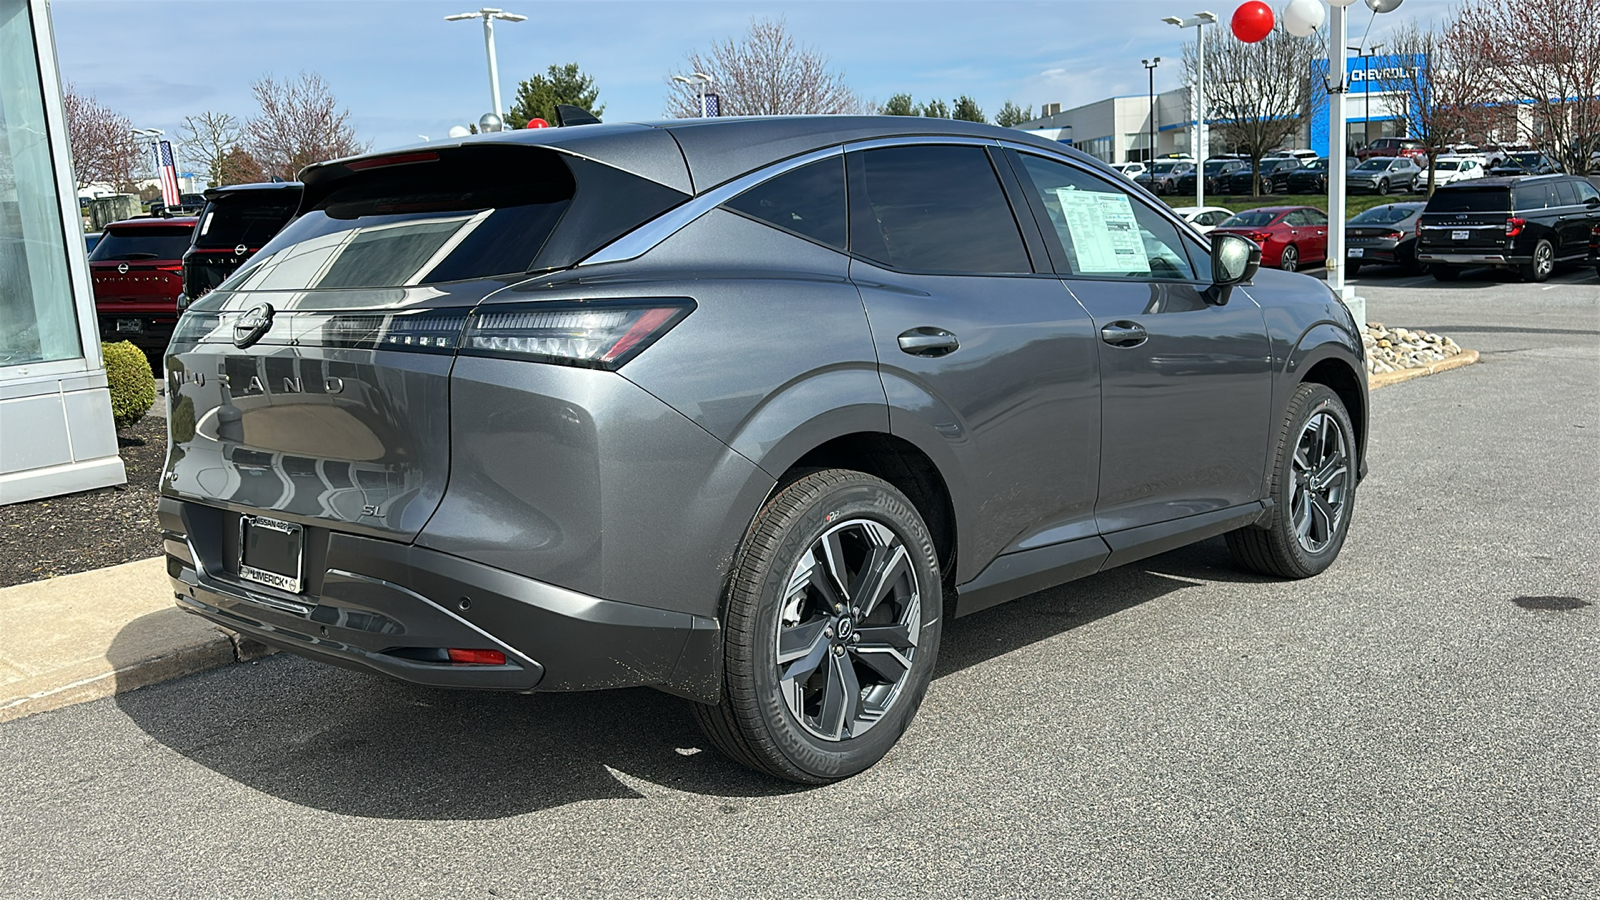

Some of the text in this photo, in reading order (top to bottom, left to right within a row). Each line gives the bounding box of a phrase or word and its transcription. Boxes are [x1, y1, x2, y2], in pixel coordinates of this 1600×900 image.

[173, 370, 345, 394] MURANO
[361, 504, 386, 518] SL
[256, 517, 276, 528] NISSAN
[872, 490, 938, 577] BRIDGESTONE
[252, 571, 285, 588] LIMERICK
